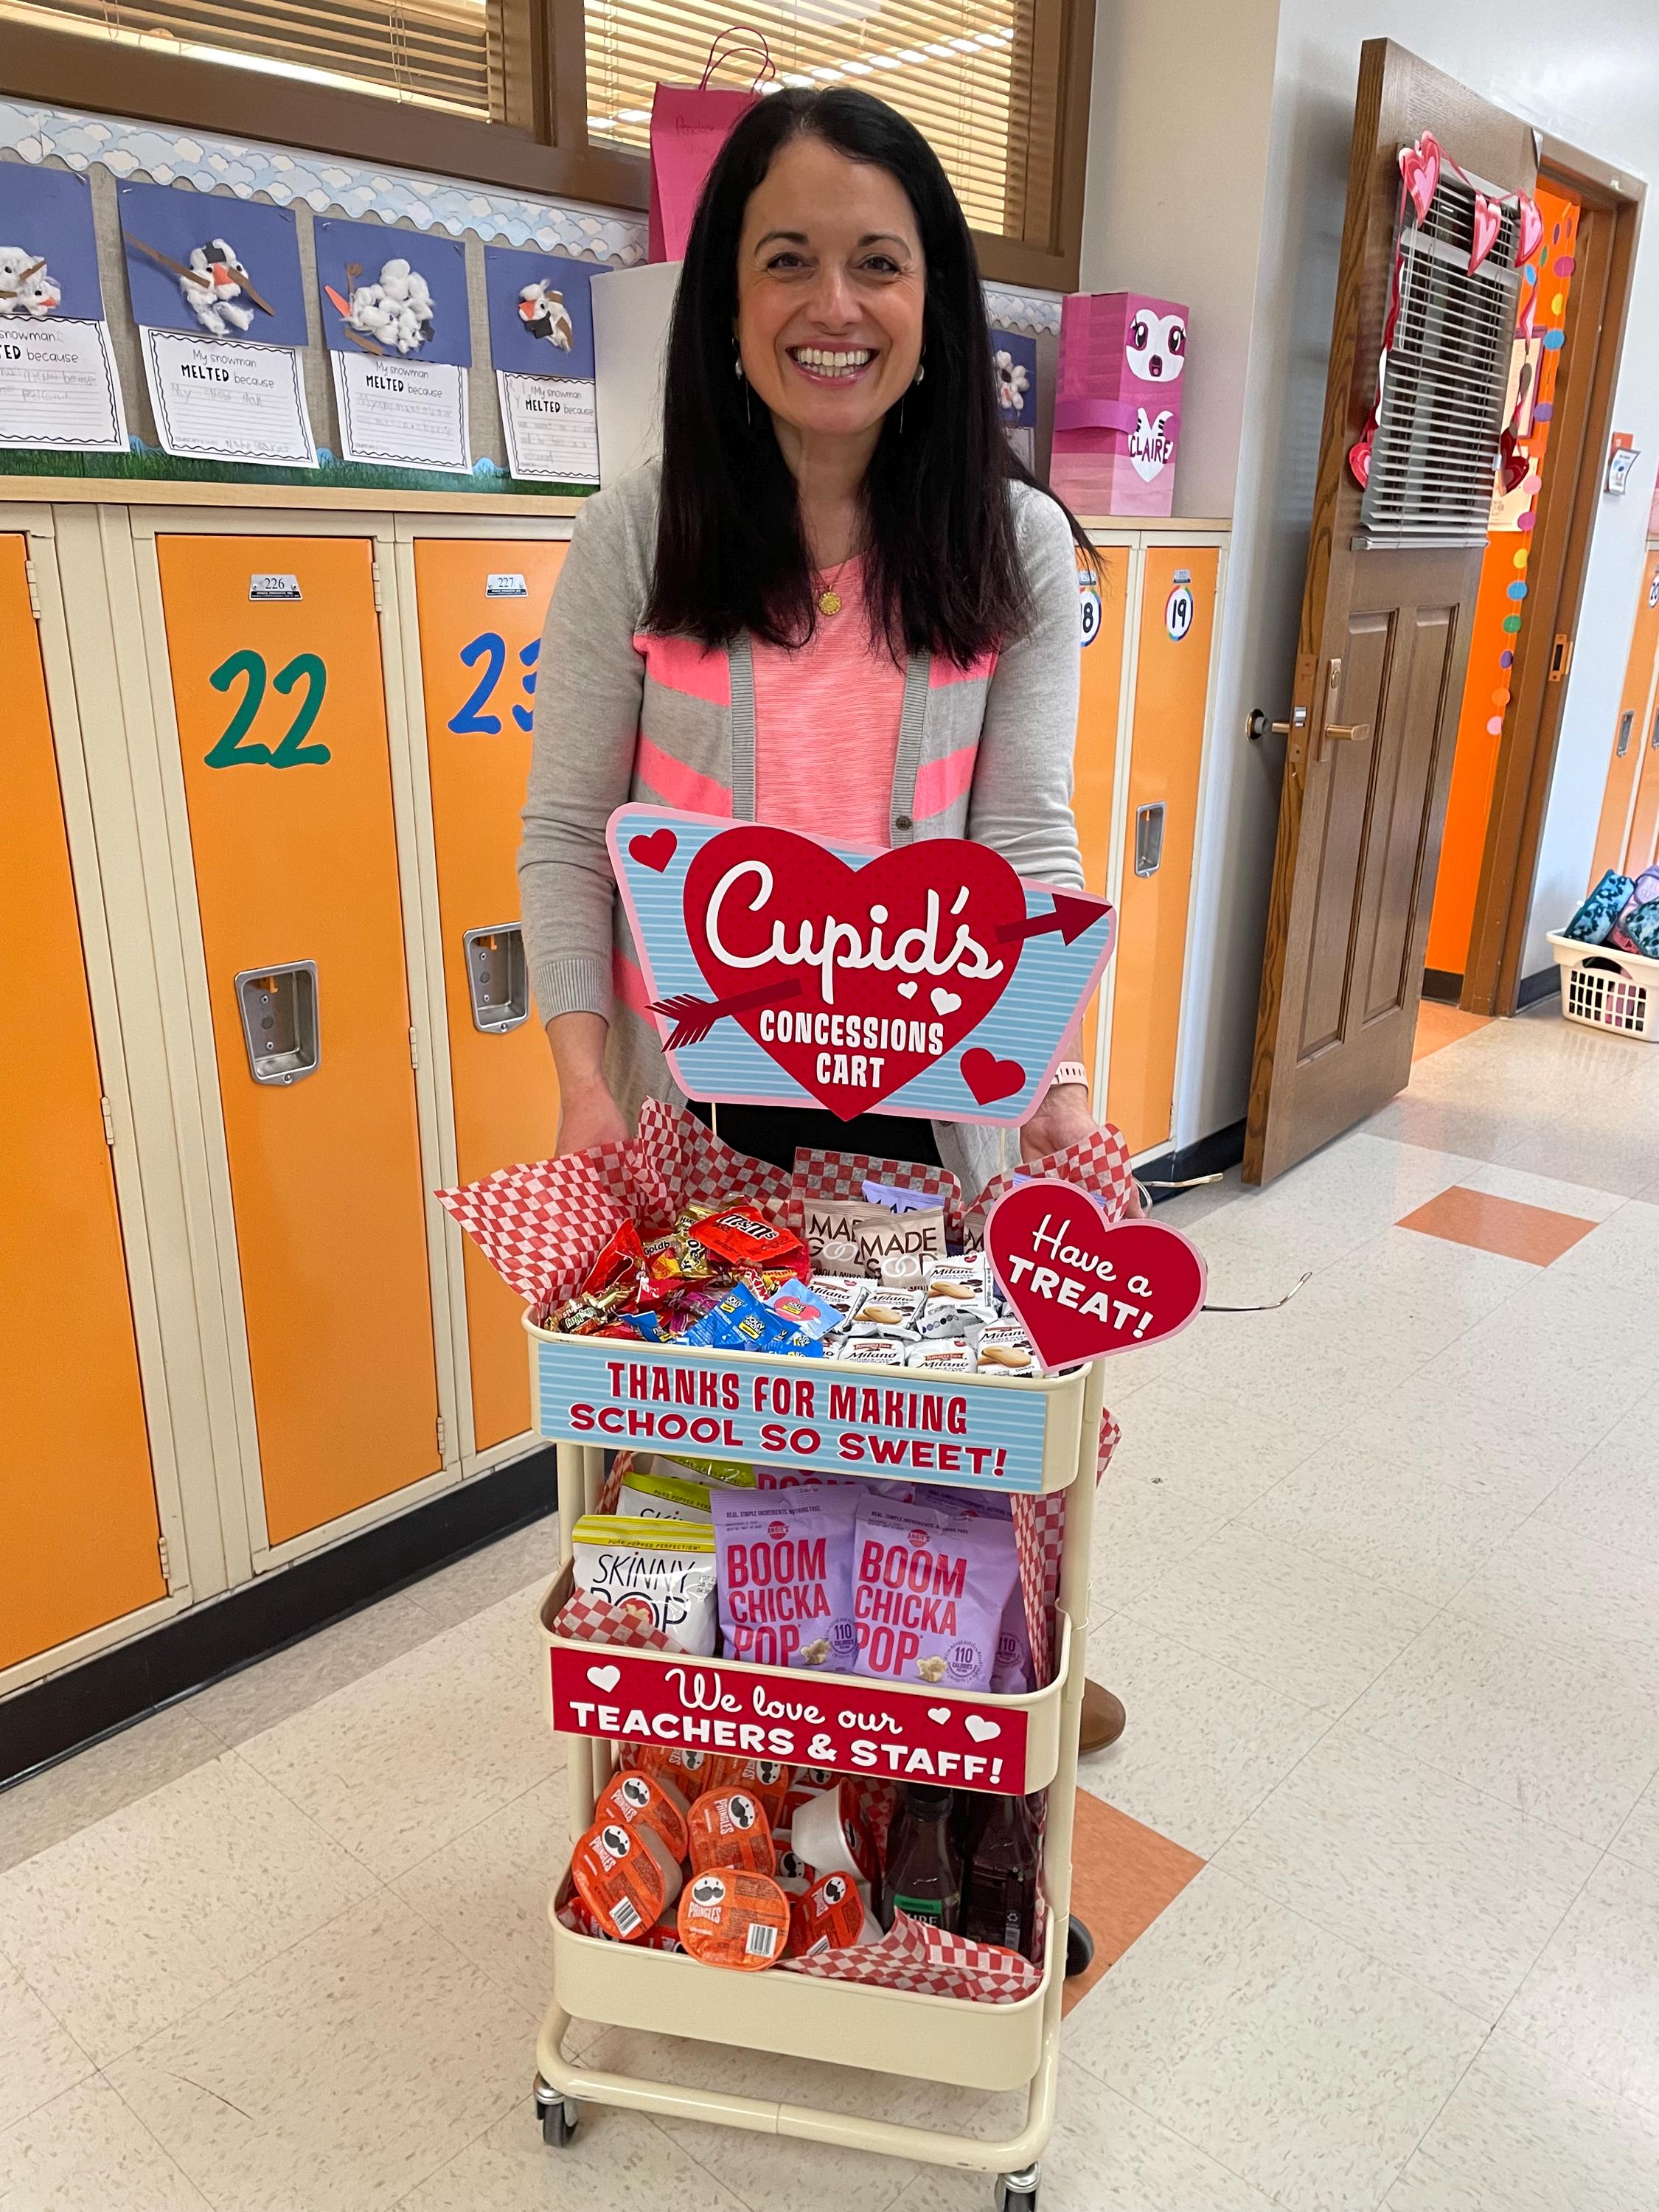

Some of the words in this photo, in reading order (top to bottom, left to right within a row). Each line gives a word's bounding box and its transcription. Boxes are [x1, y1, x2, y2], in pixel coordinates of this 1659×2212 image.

[0, 332, 55, 342] snowman
[0, 344, 21, 360] ED
[27, 348, 79, 363] because
[193, 349, 208, 366] My
[211, 355, 257, 368] snowman
[181, 364, 229, 382] MELTED
[234, 373, 274, 389] because
[376, 361, 389, 377] My
[389, 365, 429, 379] snowman
[366, 375, 404, 392] MELTED
[408, 383, 443, 398] because
[535, 386, 546, 400] My
[547, 389, 582, 400] snowman
[525, 399, 560, 413] MELTED
[563, 403, 594, 417] because
[1129, 435, 1171, 465] CLAIRE
[264, 577, 285, 590] 226
[498, 577, 514, 588] 227
[1081, 602, 1093, 633] 8
[1172, 598, 1187, 629] 19
[204, 649, 331, 769] 22
[706, 860, 1004, 1004] Cupid's
[759, 1008, 945, 1057] CONCESSIONS
[816, 1052, 885, 1088] CART
[860, 1227, 938, 1260] MADE
[1032, 1214, 1117, 1281] Have
[1127, 1275, 1153, 1298] a
[807, 1285, 850, 1299] Milano
[1008, 1253, 1154, 1339] TREAT!
[746, 1315, 765, 1329] JOLLY
[846, 1352, 897, 1360] Milano
[605, 1361, 740, 1411] THANKS
[753, 1376, 815, 1419] FOR
[827, 1384, 968, 1435] MAKING
[568, 1403, 743, 1447] SCHOOL
[759, 1423, 821, 1455] SO
[838, 1432, 1008, 1477] SWEET!
[653, 1489, 670, 1500] PURE
[672, 1495, 695, 1506] POPPED
[886, 1514, 903, 1522] SIMPLE
[727, 1538, 827, 1589] BOOM
[858, 1540, 967, 1599] BOOM
[728, 1583, 832, 1624] CHICKA
[854, 1585, 957, 1636] CHICKA
[732, 1624, 800, 1667] POP
[834, 1624, 852, 1641] 110
[998, 1636, 1015, 1653] 110
[855, 1622, 919, 1676] POP
[954, 1646, 974, 1663] 110
[951, 1661, 973, 1671] CALORIES
[665, 1668, 742, 1712] We
[752, 1686, 826, 1725] love
[838, 1709, 903, 1736] our
[569, 1701, 794, 1755] TEACHERS
[807, 1733, 838, 1762] &
[850, 1739, 1004, 1784] STAFF!
[610, 1789, 637, 1823] PRINGLES
[714, 1798, 734, 1835] PRINGLES
[589, 1834, 617, 1873] PRINGLES
[687, 1901, 722, 1924] PRINGLES
